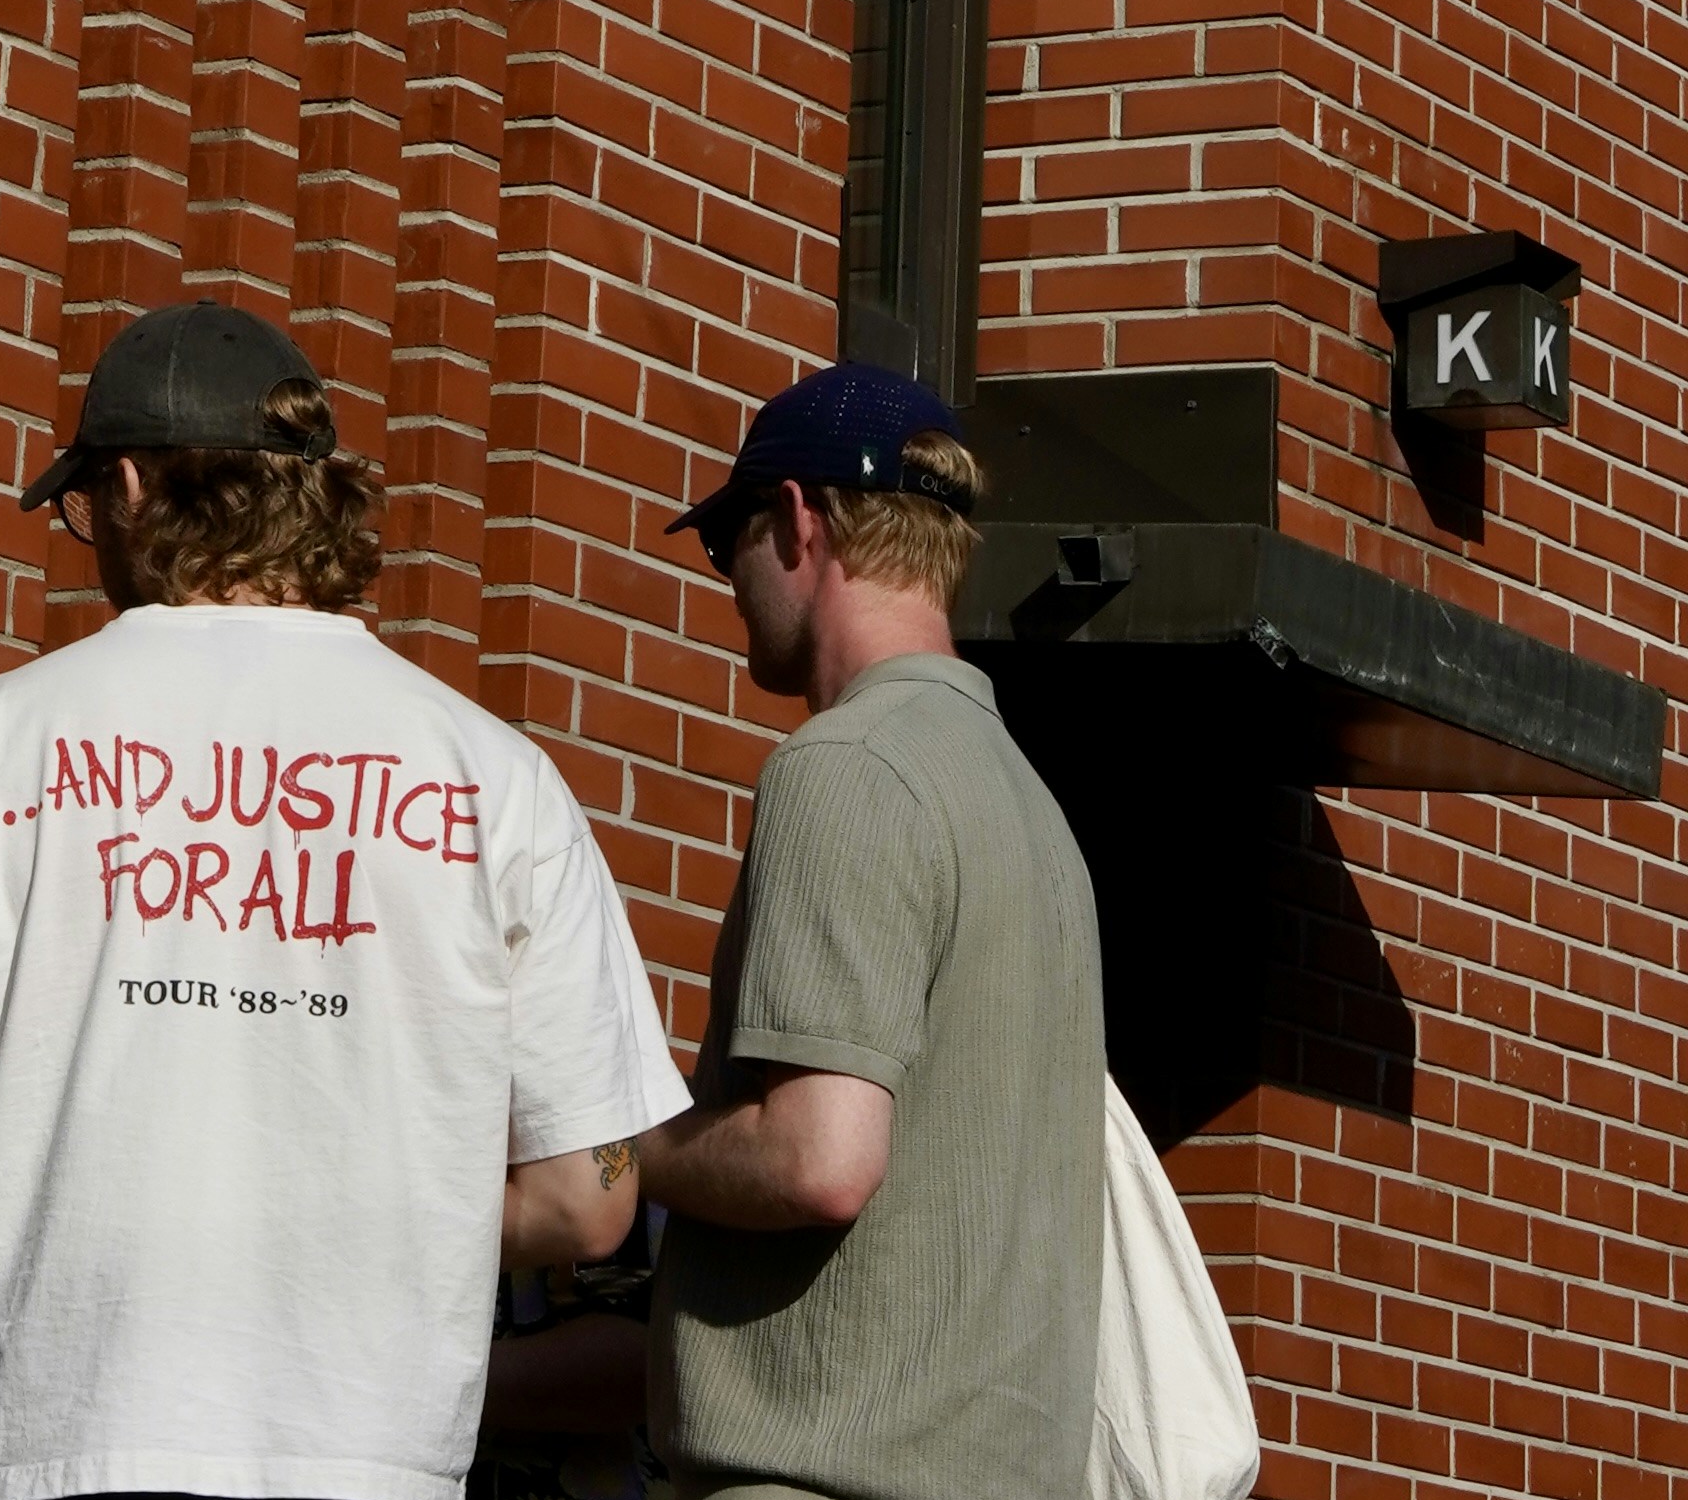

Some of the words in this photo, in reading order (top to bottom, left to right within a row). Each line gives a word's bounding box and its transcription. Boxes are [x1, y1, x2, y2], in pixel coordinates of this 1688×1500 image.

[1437, 310, 1492, 384] K
[1534, 316, 1557, 396] K
[181, 740, 480, 864] JUSTICE
[97, 832, 229, 935] FOR
[239, 849, 376, 947] ALL
[119, 980, 219, 1008] TOUR
